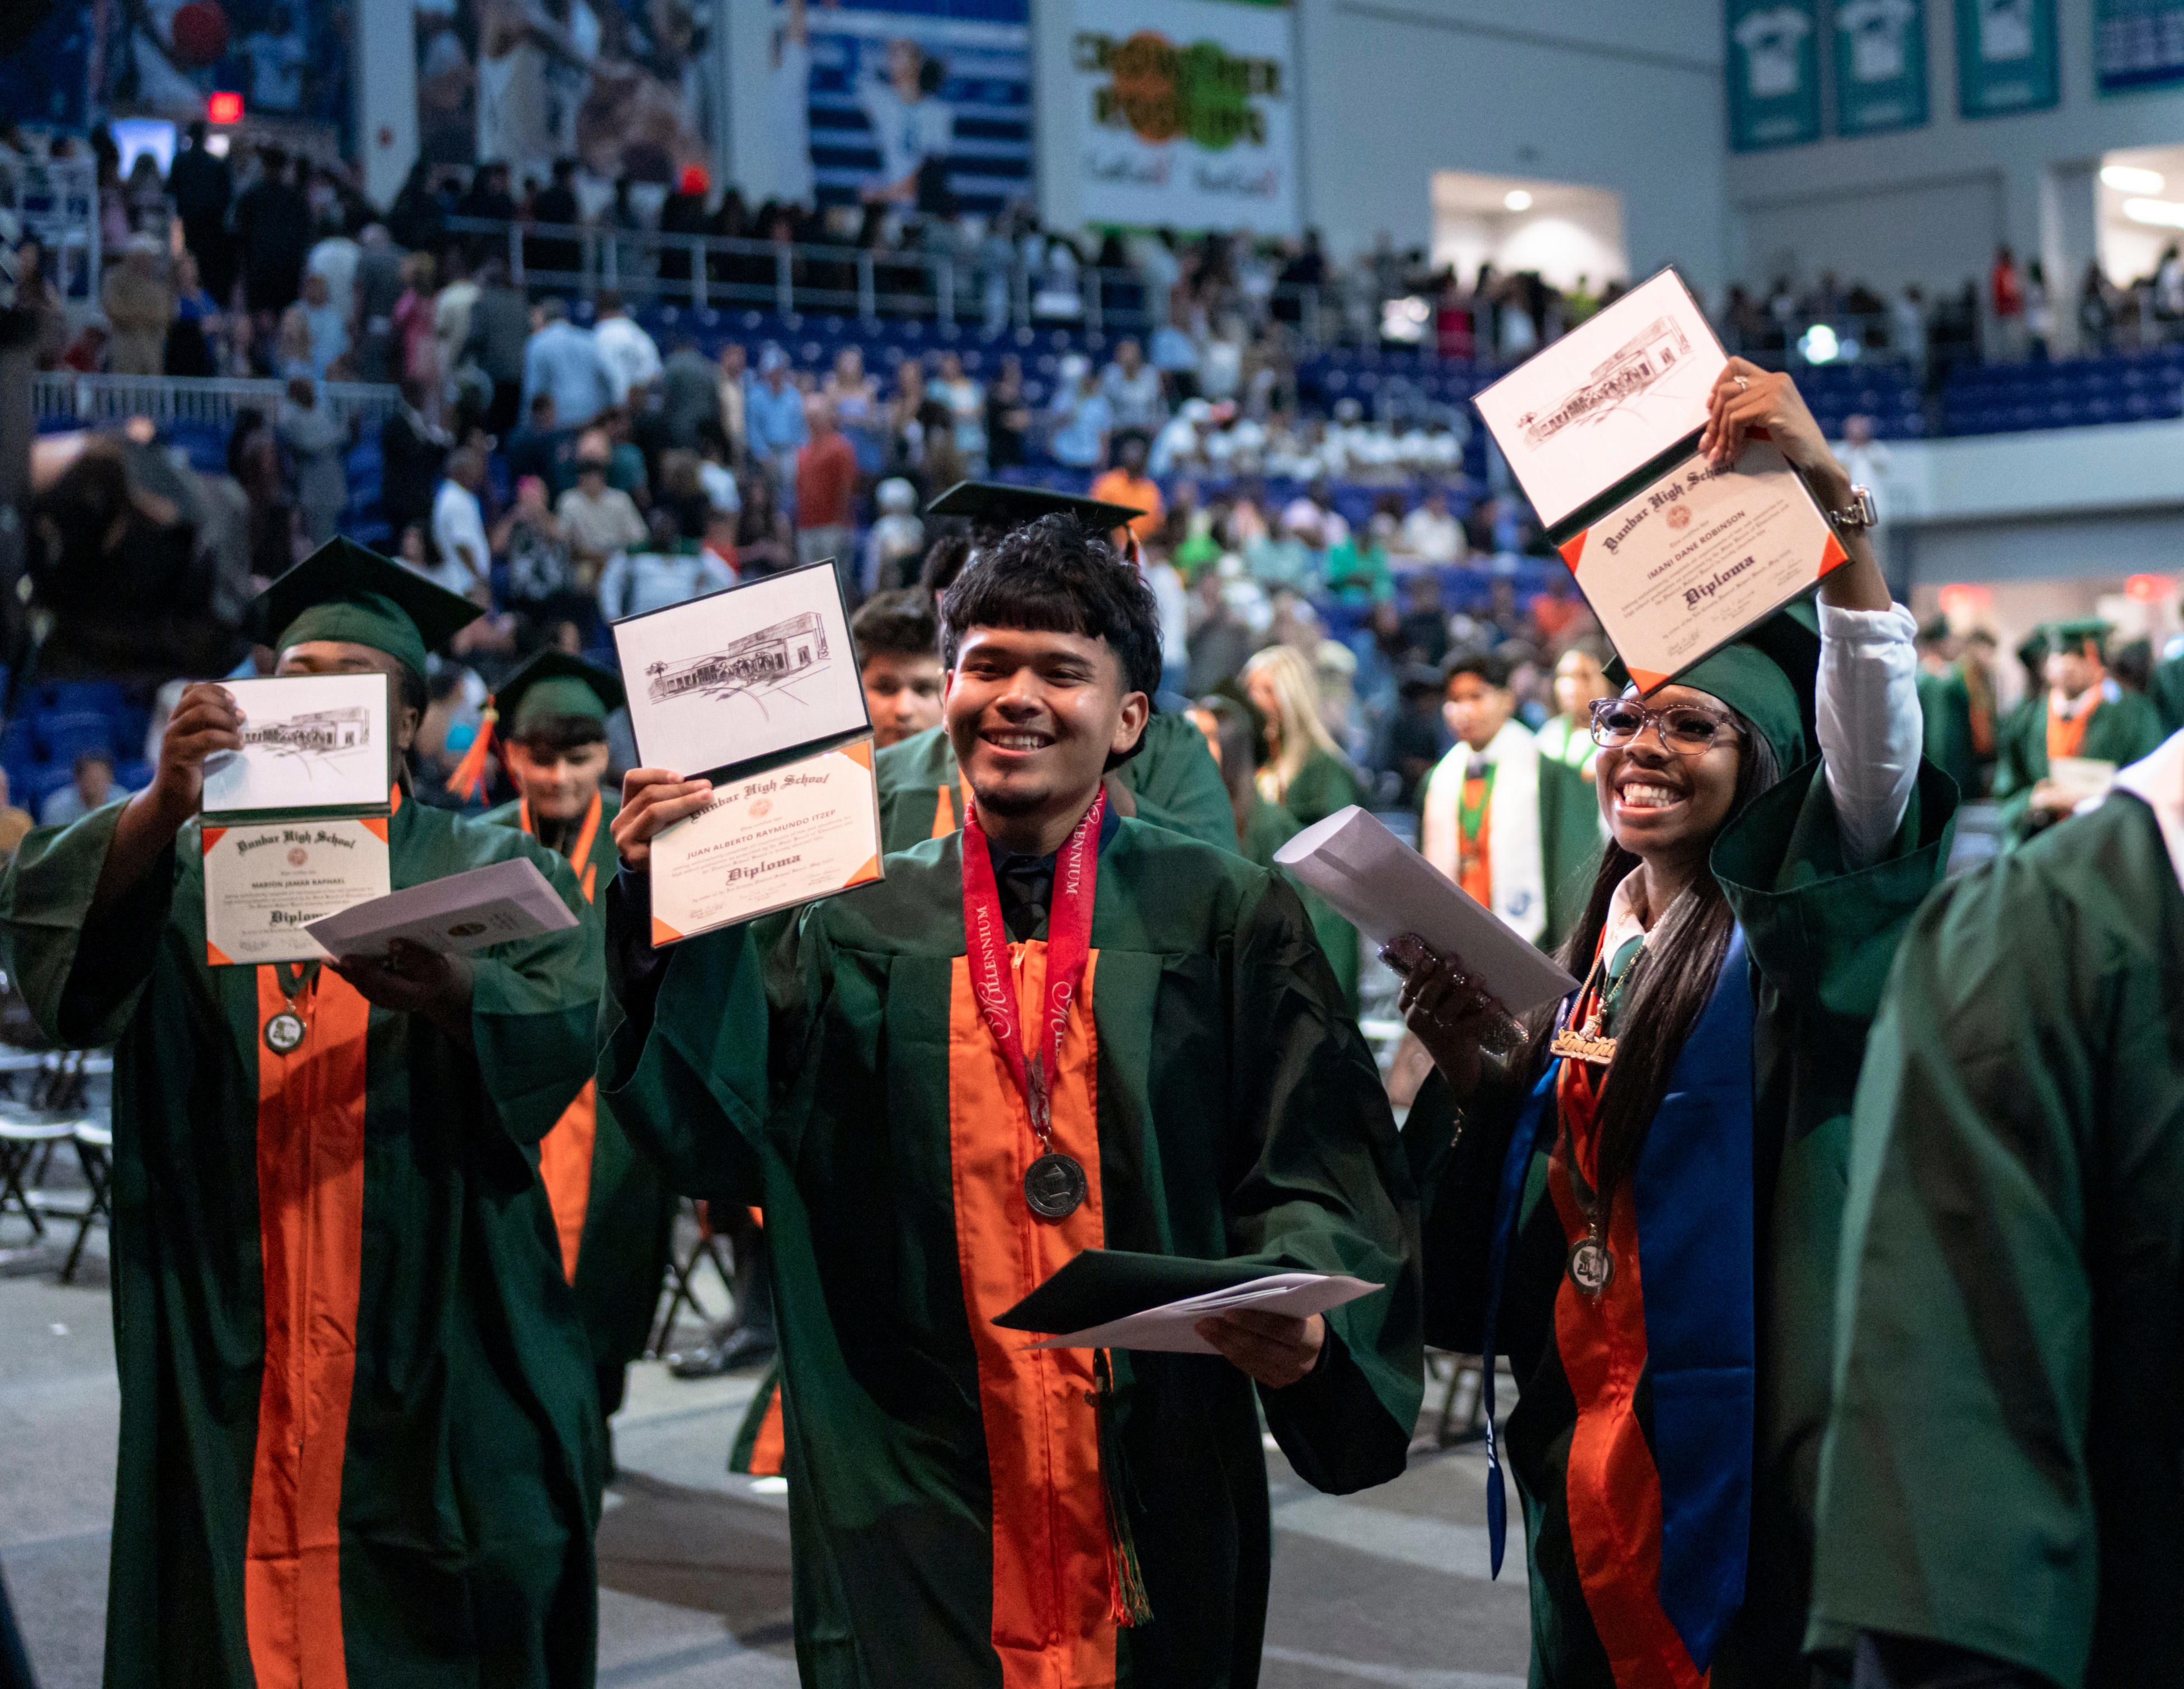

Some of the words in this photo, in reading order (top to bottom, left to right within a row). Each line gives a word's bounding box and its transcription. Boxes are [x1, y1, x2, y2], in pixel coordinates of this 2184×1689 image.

[1602, 508, 1648, 554] Dunbar
[1648, 483, 1685, 512] High
[1648, 559, 1673, 580] IMANI
[1674, 541, 1699, 562] DANE
[1699, 510, 1745, 544] ROBINSON
[1682, 555, 1755, 611] Diploma
[744, 780, 777, 799] High
[780, 773, 831, 790] School
[237, 836, 279, 856] Dunbar
[284, 830, 311, 844] High
[314, 830, 355, 848] School
[687, 847, 711, 860] JUAN
[713, 834, 753, 851] ALBERTO
[756, 817, 809, 839] RAYMUNDO
[812, 809, 836, 822] ITZEP
[725, 855, 801, 886] Diploma
[270, 910, 330, 926] Diplom
[977, 905, 1011, 1039] MILLENNIUM
